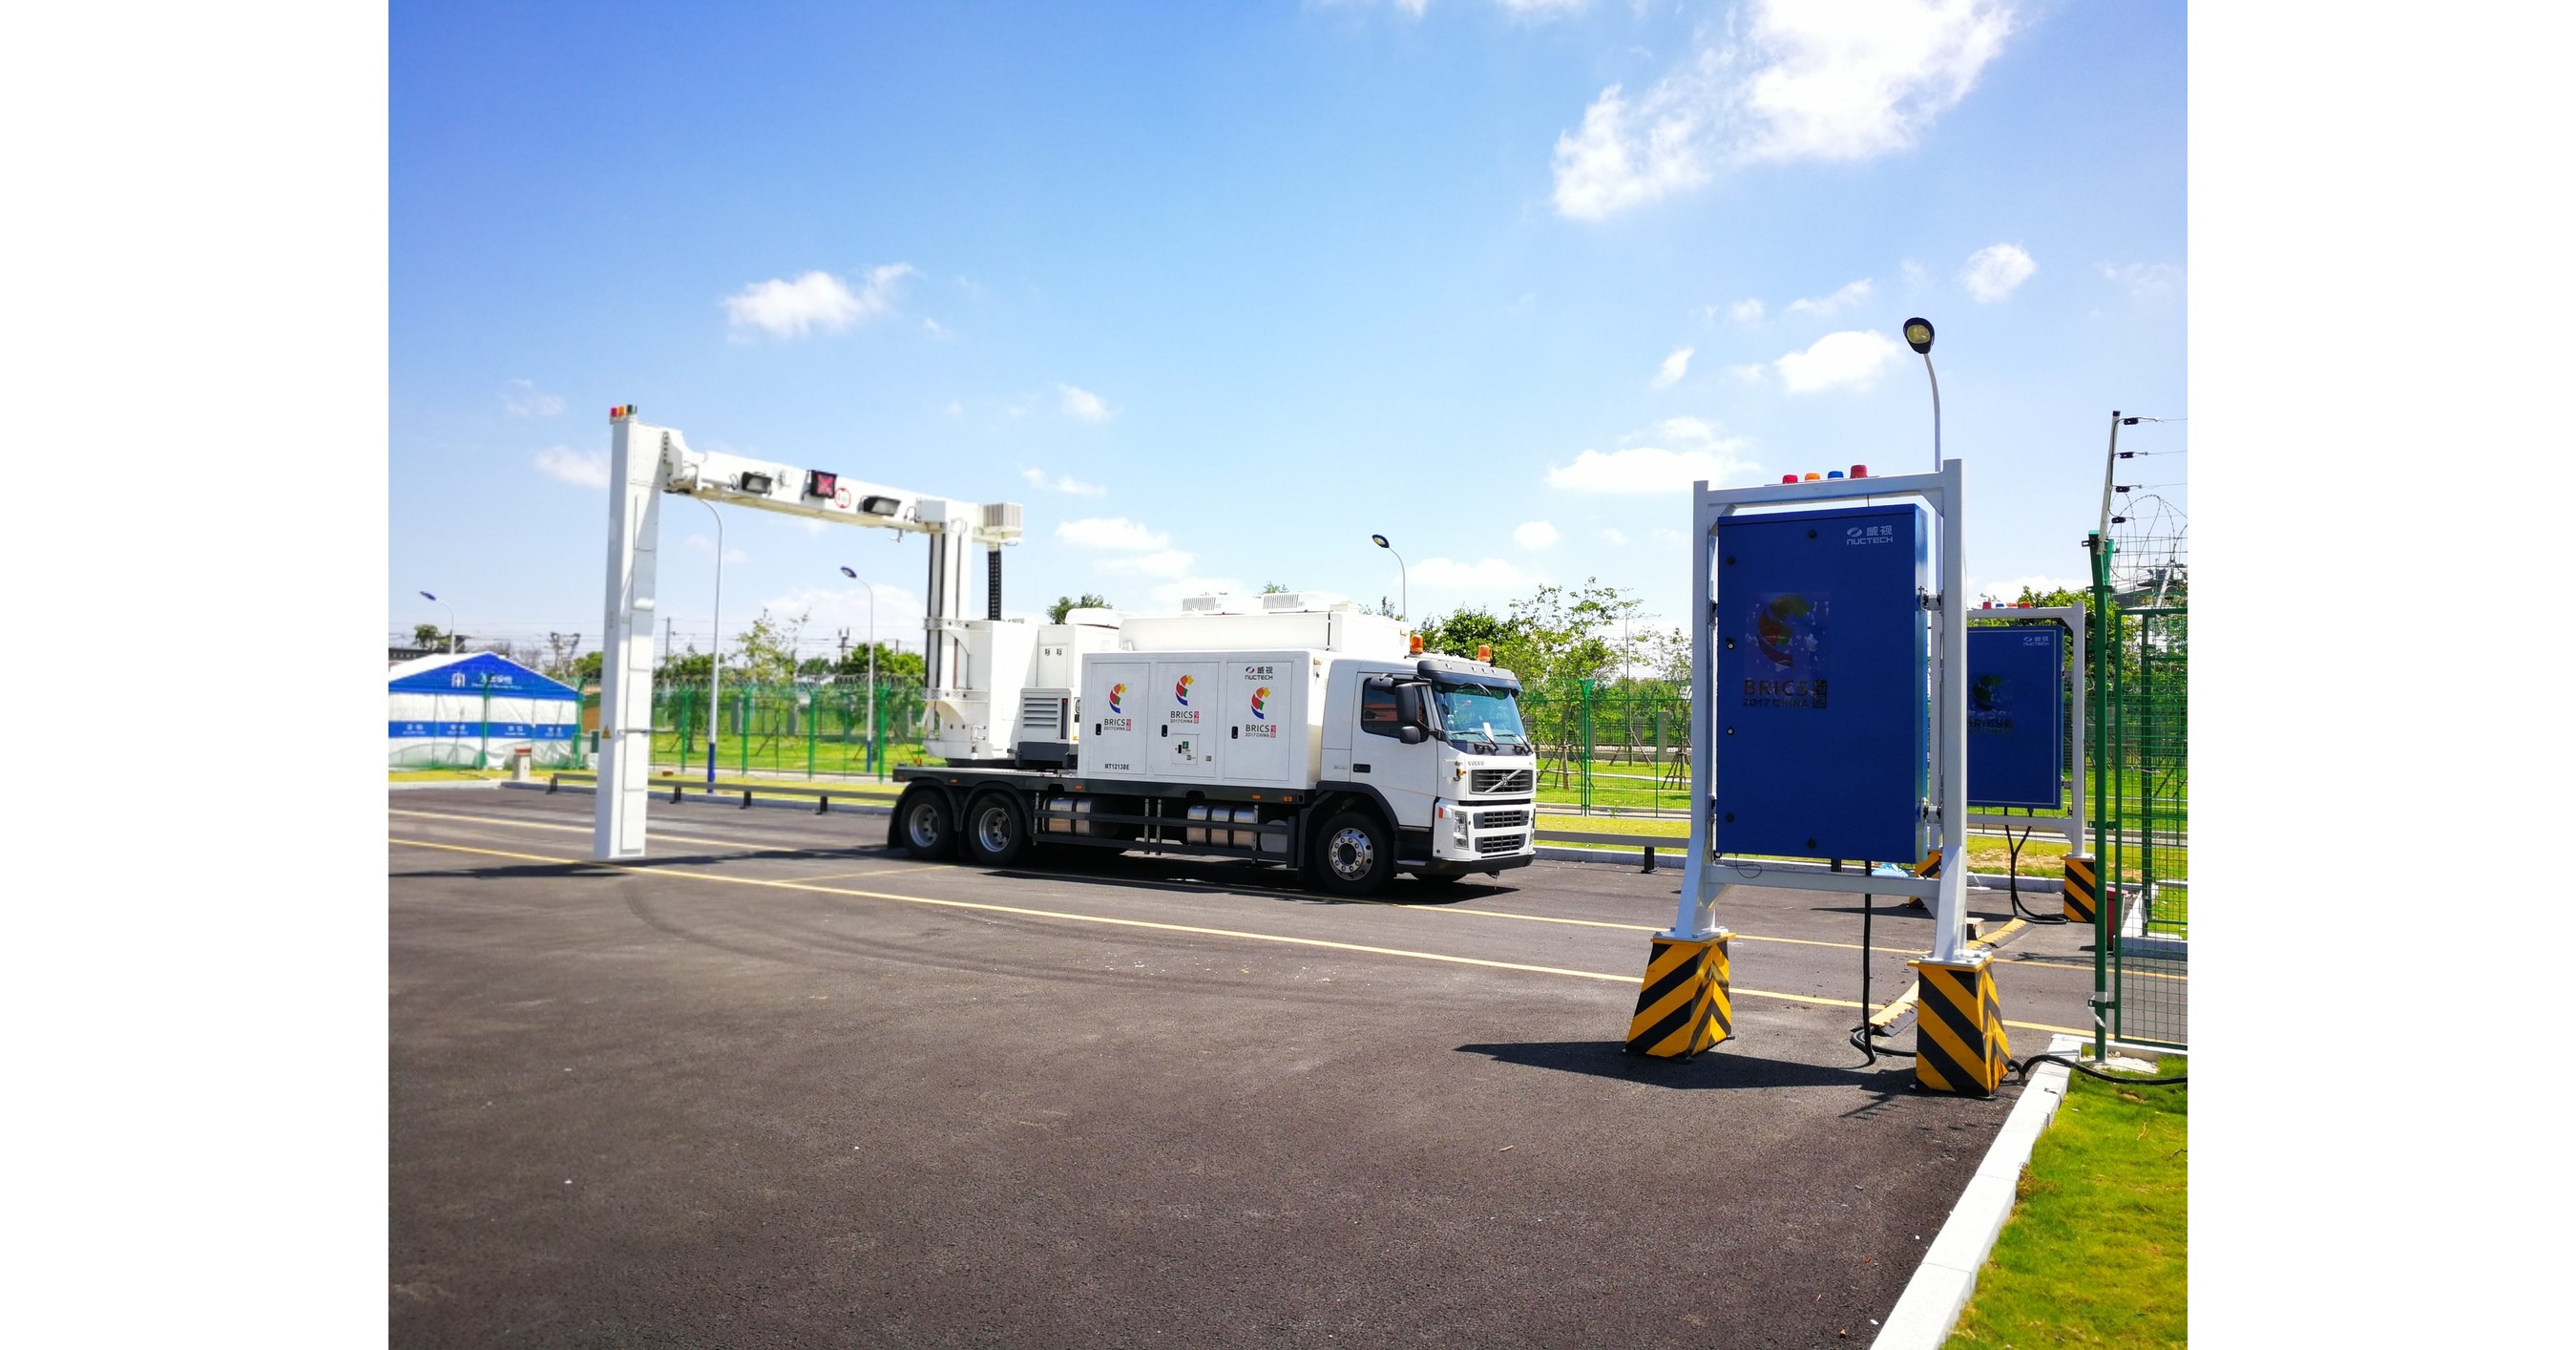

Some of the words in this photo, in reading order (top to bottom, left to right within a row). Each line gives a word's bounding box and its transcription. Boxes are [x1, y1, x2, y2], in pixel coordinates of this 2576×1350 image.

[1867, 525, 1893, 536] 威视
[1847, 537, 1894, 545] NUCTECH
[1744, 680, 1809, 696] BRICS
[1742, 698, 1770, 707] 2017
[1772, 698, 1809, 707] CHINA
[1170, 710, 1193, 719] BRICS
